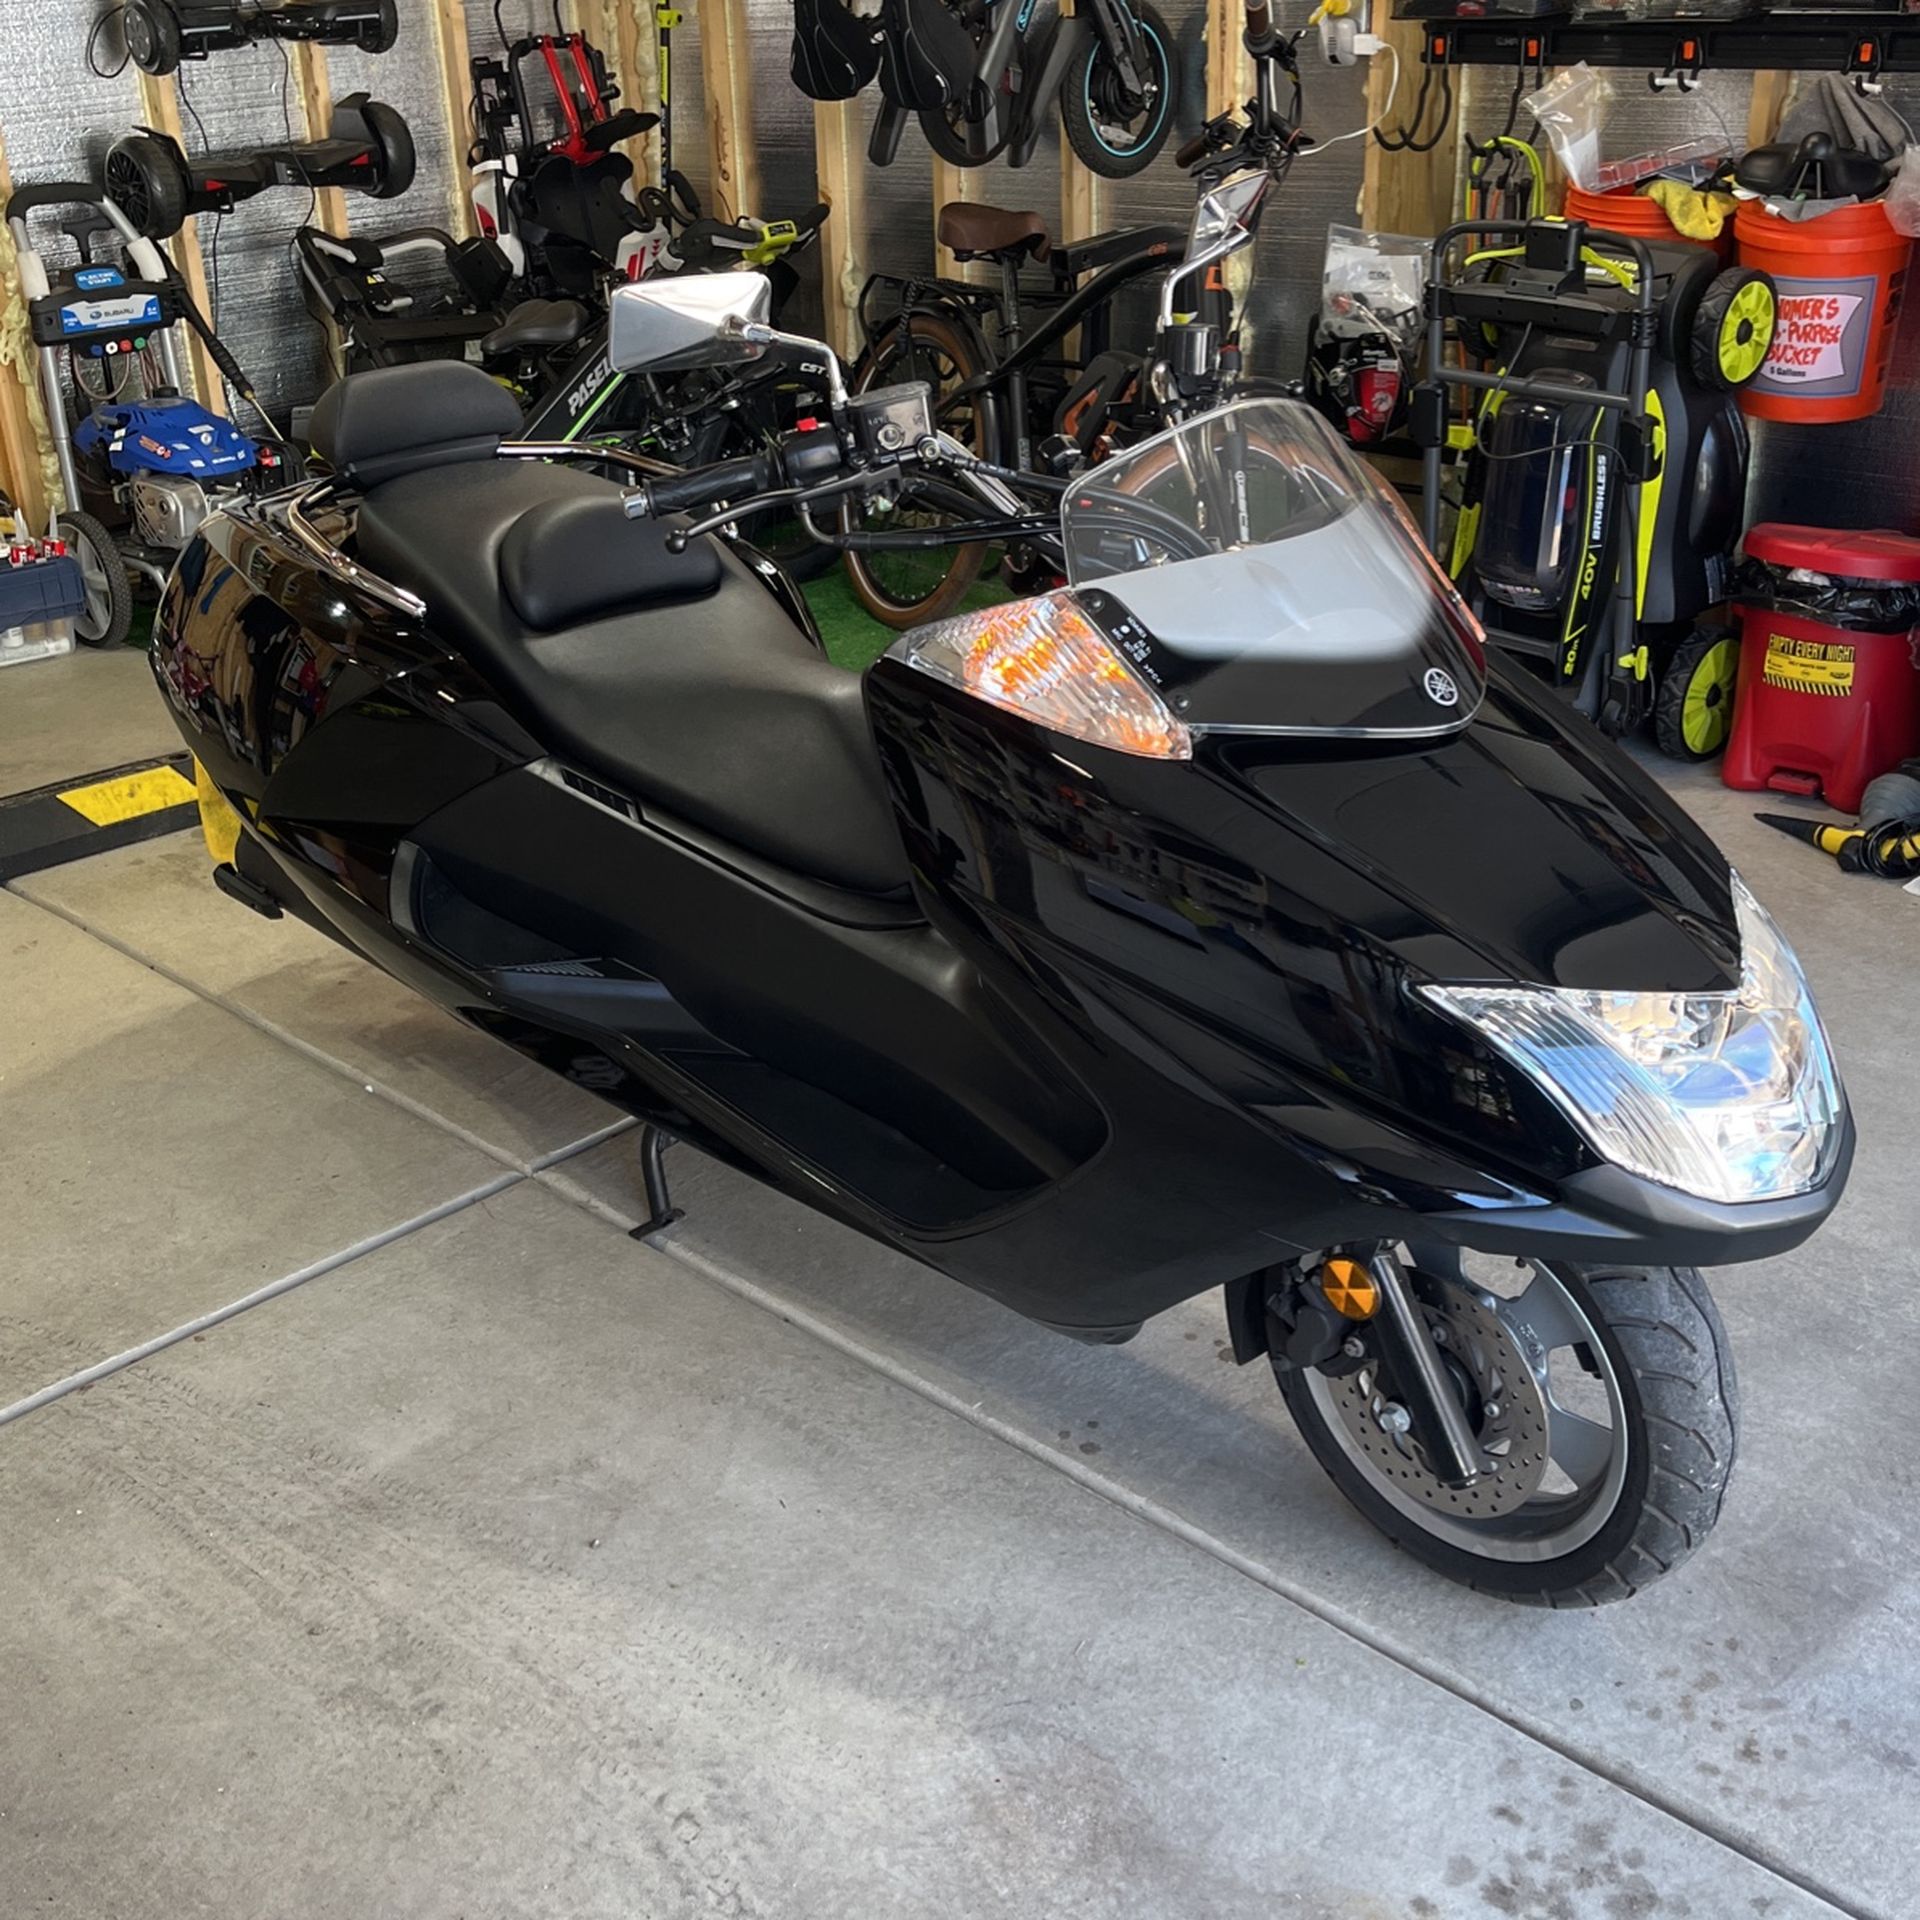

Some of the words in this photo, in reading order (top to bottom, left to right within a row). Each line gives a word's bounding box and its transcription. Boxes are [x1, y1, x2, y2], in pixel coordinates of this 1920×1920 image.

[104, 308, 134, 317] SUBARU
[800, 362, 826, 375] CST
[1770, 366, 1775, 375] 5
[1777, 366, 1806, 377] Gallons
[1581, 553, 1598, 600] 40V
[1592, 455, 1607, 541] BRUSHLESS
[1769, 634, 1795, 654] EMPTY
[1796, 641, 1825, 660] EVERY
[1826, 645, 1855, 663] NIGHT
